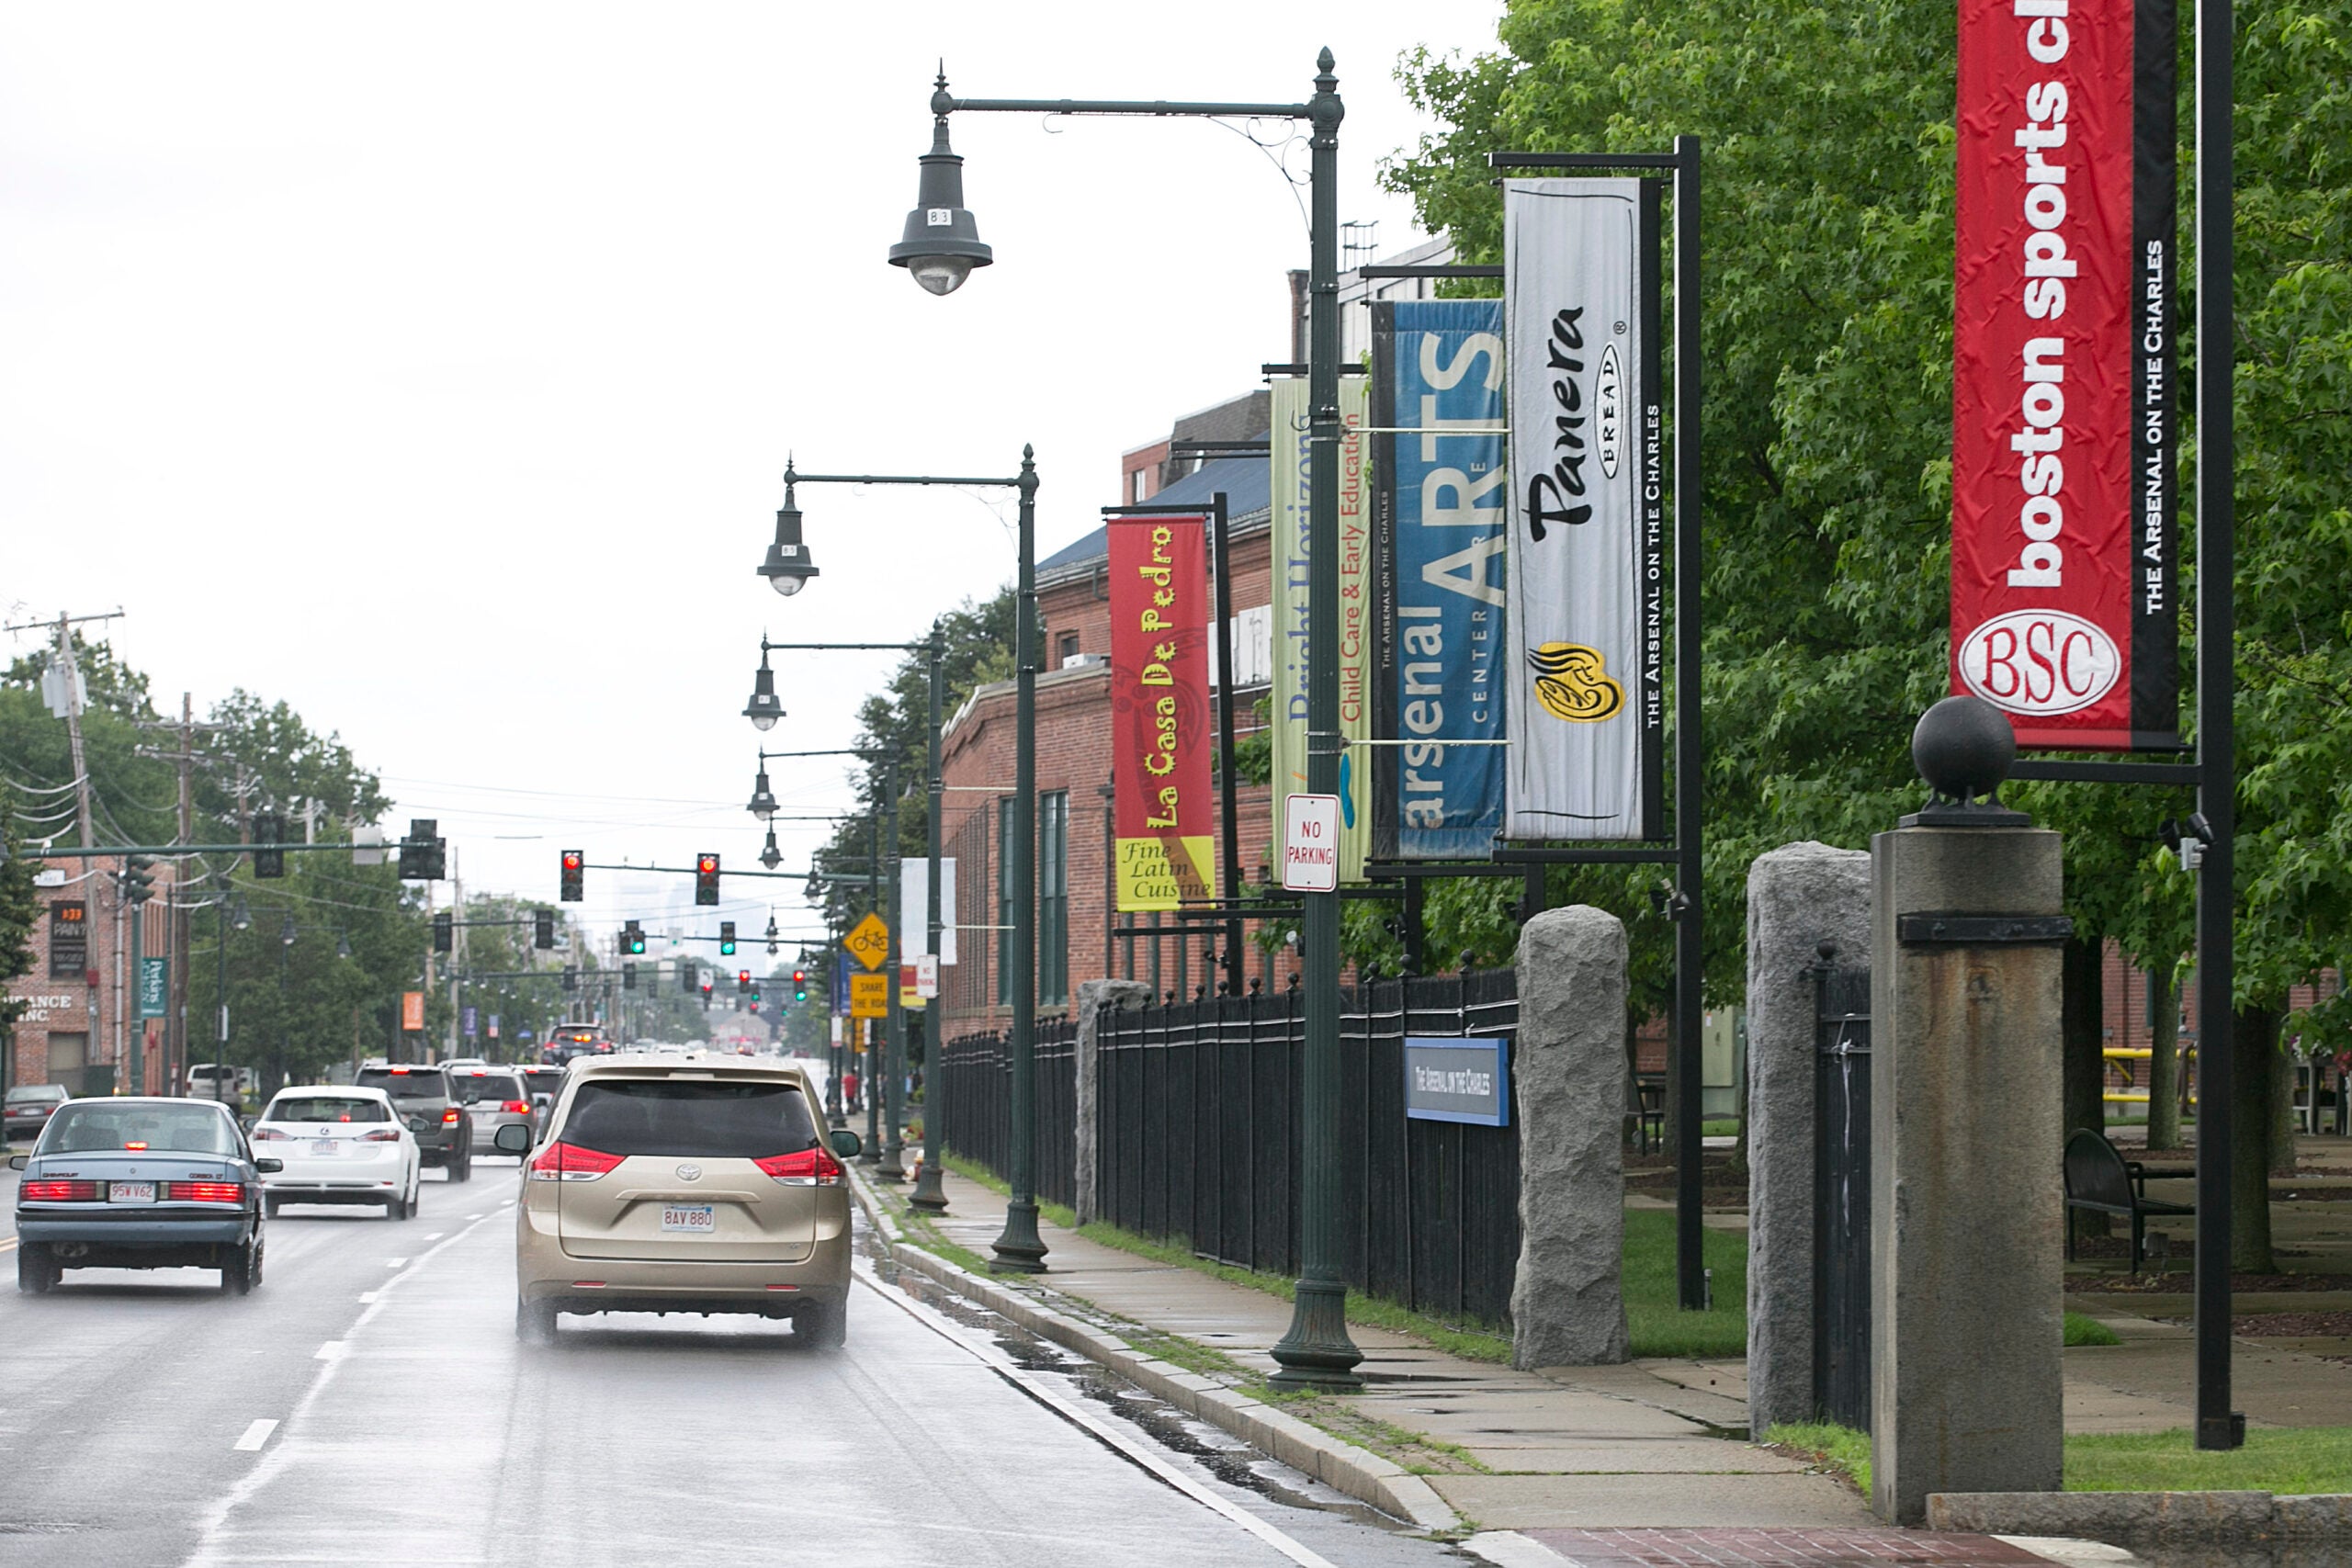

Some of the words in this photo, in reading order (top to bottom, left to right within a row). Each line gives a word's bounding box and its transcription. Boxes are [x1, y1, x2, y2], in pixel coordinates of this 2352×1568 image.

[930, 211, 947, 222] 83
[2015, 81, 2077, 320] sports
[2143, 240, 2164, 353] CHARLES
[2146, 357, 2164, 405] THE
[1521, 306, 1592, 542] Panera
[1602, 361, 1616, 463] BREAD
[2146, 410, 2164, 445] ON
[1340, 413, 1360, 516] Education
[1419, 332, 1504, 608] ARTS
[1645, 404, 1660, 501] CHARLES
[2007, 337, 2064, 588] boston
[1380, 491, 1389, 544] CHARLES
[1647, 508, 1660, 546] THE
[2143, 449, 2164, 558] ARSENAL
[1340, 525, 1366, 575] Early
[1647, 553, 1660, 580] ON
[1139, 525, 1175, 633] Pedro
[1341, 583, 1360, 599] &
[2146, 567, 2164, 615] THE
[1340, 606, 1361, 659] Care
[1381, 591, 1391, 645] ARSENAL
[1645, 586, 1660, 683] ARSENAL
[1141, 642, 1177, 685] De
[1382, 646, 1391, 670] THE
[1472, 610, 1487, 724] CENTER
[1981, 621, 2096, 704] BSC
[1341, 667, 1361, 722] Child
[1397, 606, 1444, 829] arsenal
[1647, 689, 1660, 729] THE
[1144, 696, 1177, 776] Casa
[1147, 786, 1179, 829] La
[1302, 821, 1322, 838] NO
[1122, 841, 1171, 863] Fine
[1130, 861, 1189, 878] Latin
[1288, 846, 1332, 864] PARKING
[1134, 880, 1211, 898] Cuisine
[870, 998, 887, 1009] ROA
